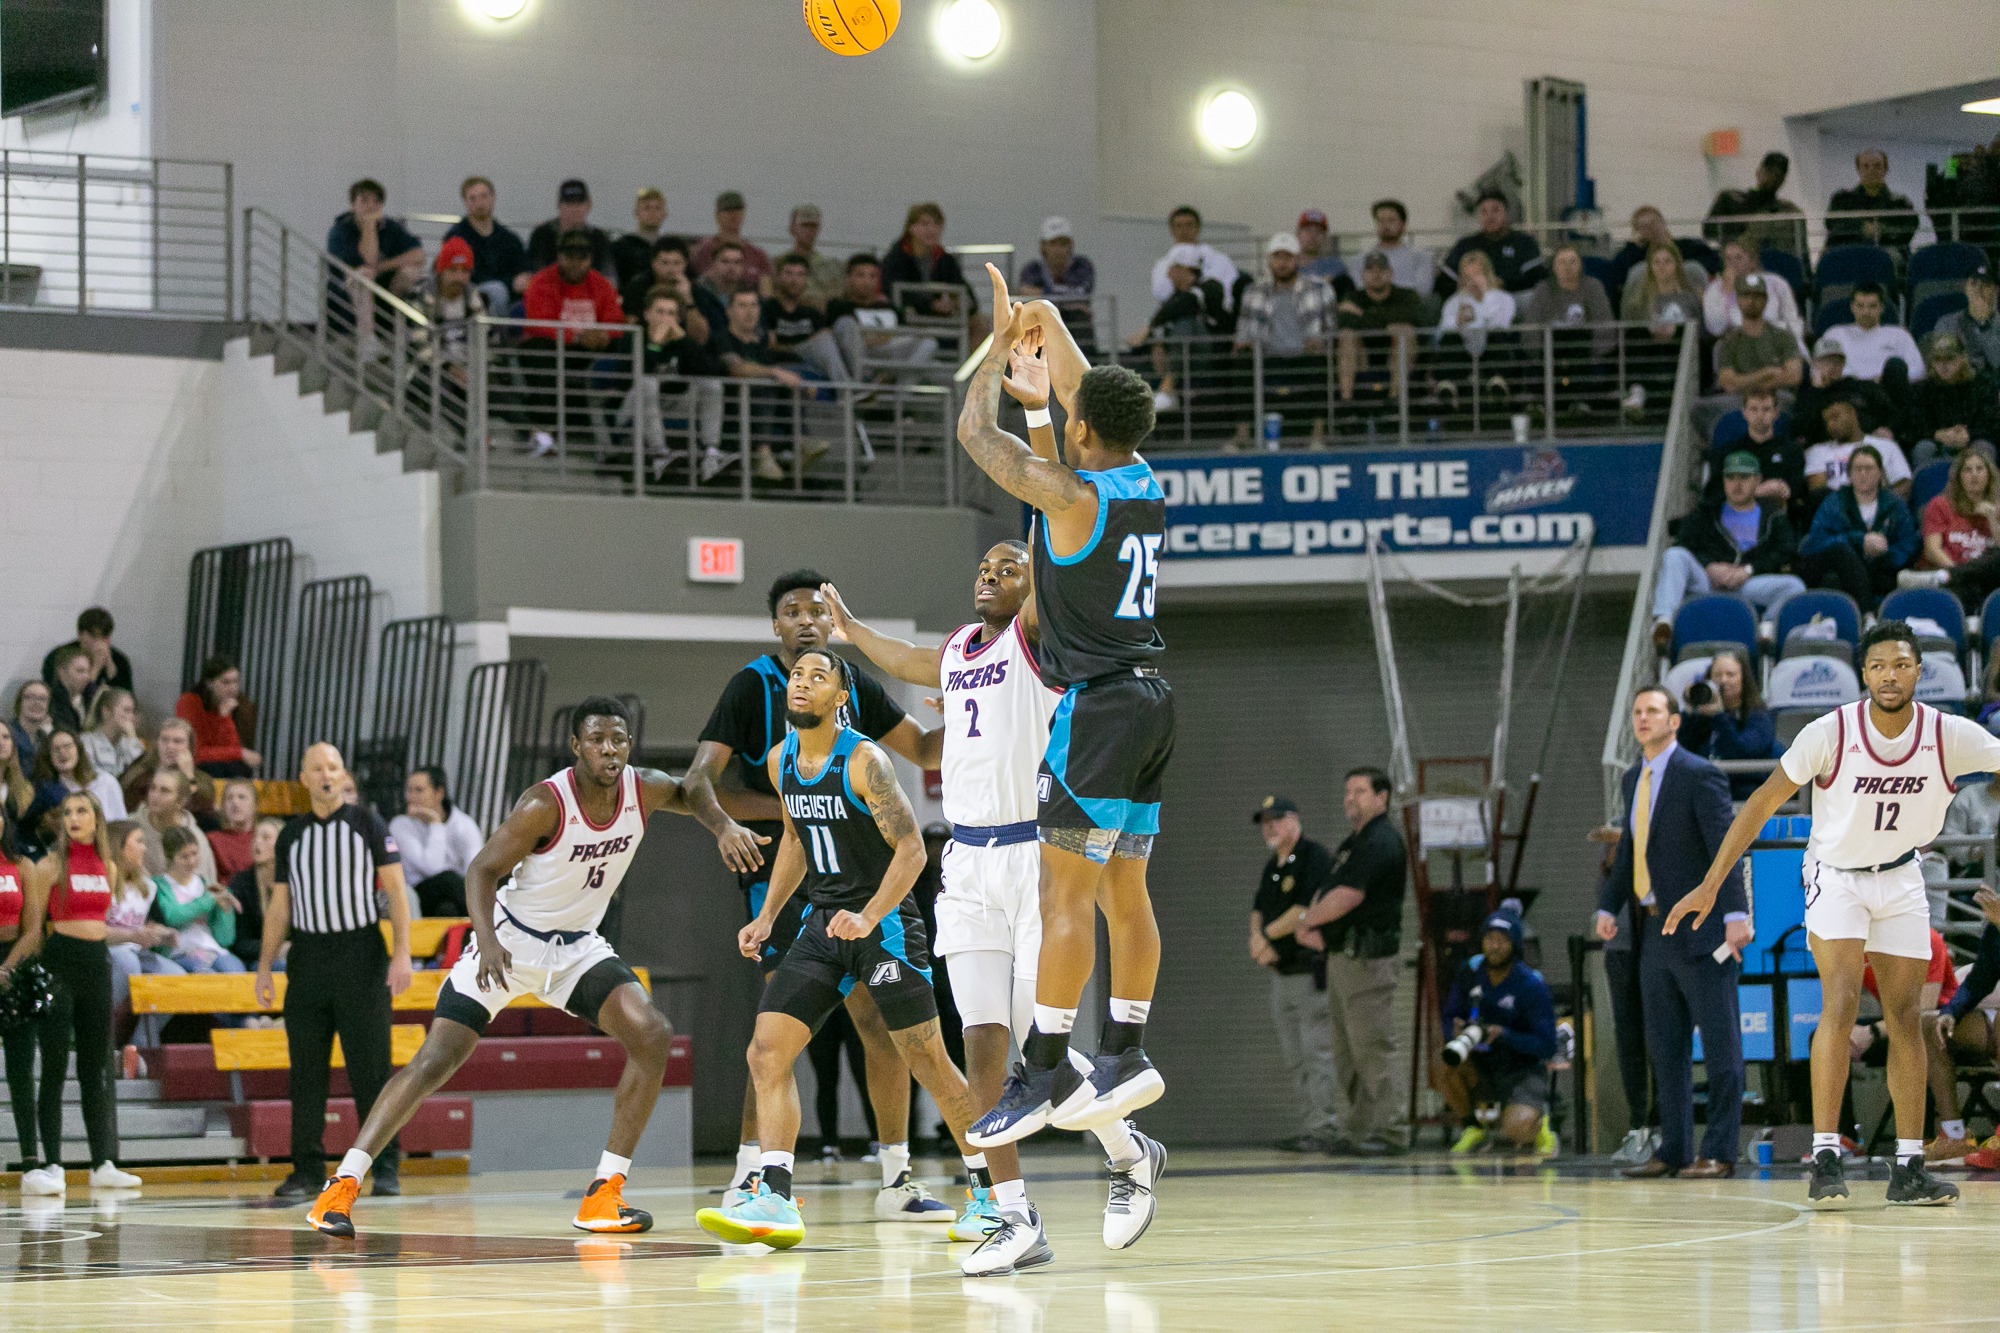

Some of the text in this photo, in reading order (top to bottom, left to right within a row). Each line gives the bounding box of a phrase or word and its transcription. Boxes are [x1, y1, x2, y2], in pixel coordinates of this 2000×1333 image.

[1154, 460, 1470, 506] OME OF THE
[1164, 512, 1594, 556] cersports.com
[700, 543, 736, 574] EXIT
[1113, 533, 1163, 620] 25
[945, 659, 1009, 693] PACERS
[964, 698, 982, 738] 2
[1853, 775, 1929, 795] PACERS
[1874, 801, 1901, 832] 12
[568, 834, 634, 863] PACERS
[805, 825, 842, 875] 11
[581, 861, 609, 890] 15
[868, 959, 902, 986] A
